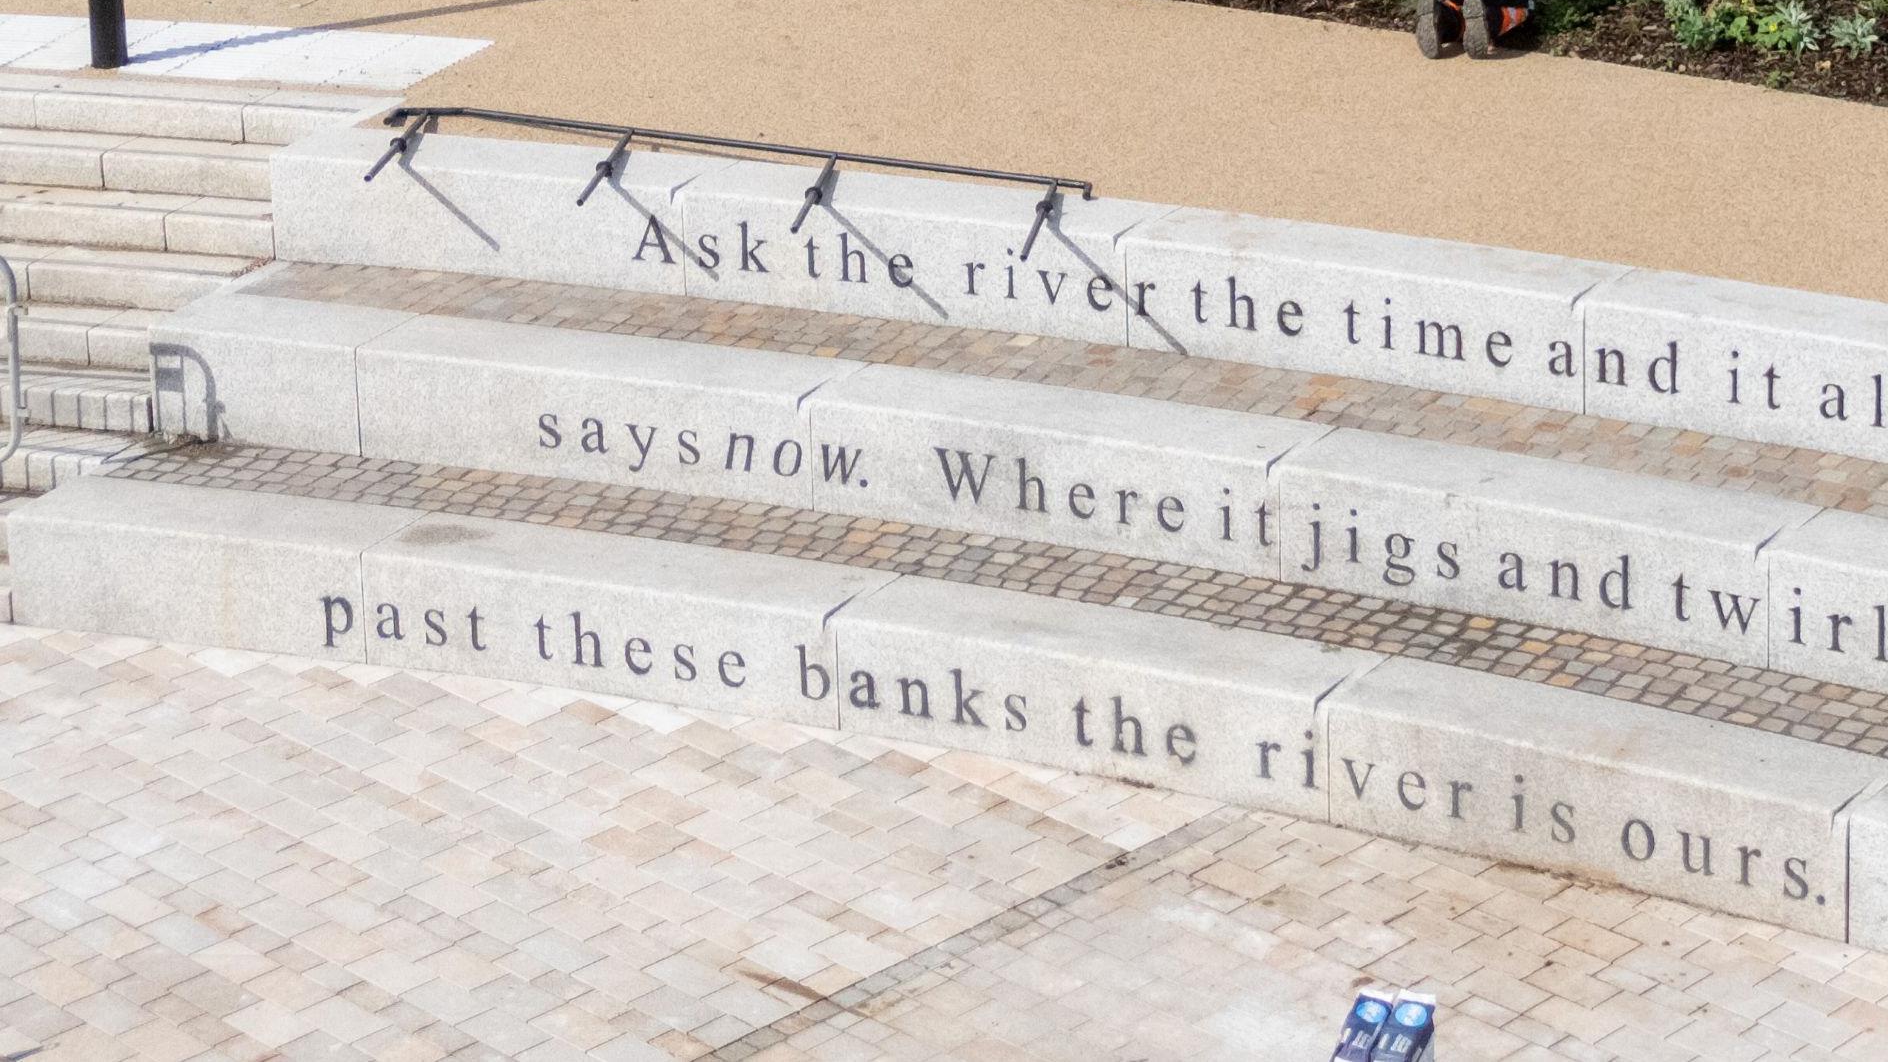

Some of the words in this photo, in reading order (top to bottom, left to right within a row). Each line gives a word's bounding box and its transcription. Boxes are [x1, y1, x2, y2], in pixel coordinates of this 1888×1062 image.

[632, 214, 768, 272] Ask
[803, 233, 916, 289] the
[963, 248, 1156, 316] river
[1191, 276, 1304, 337] the
[1343, 298, 1512, 368] time
[1547, 340, 1680, 394] and
[1728, 350, 1781, 410] it
[539, 414, 700, 472] says
[724, 432, 870, 488] now.
[934, 446, 1186, 531] Where
[1219, 488, 1273, 547] it
[1301, 502, 1462, 585] jigs
[1498, 552, 1633, 611] and
[320, 594, 487, 651] past
[534, 611, 745, 688] these
[796, 644, 1029, 732] banks
[1072, 696, 1197, 766] the
[1254, 730, 1473, 820] river
[1512, 775, 1575, 843] is
[1619, 818, 1827, 906] ours.
